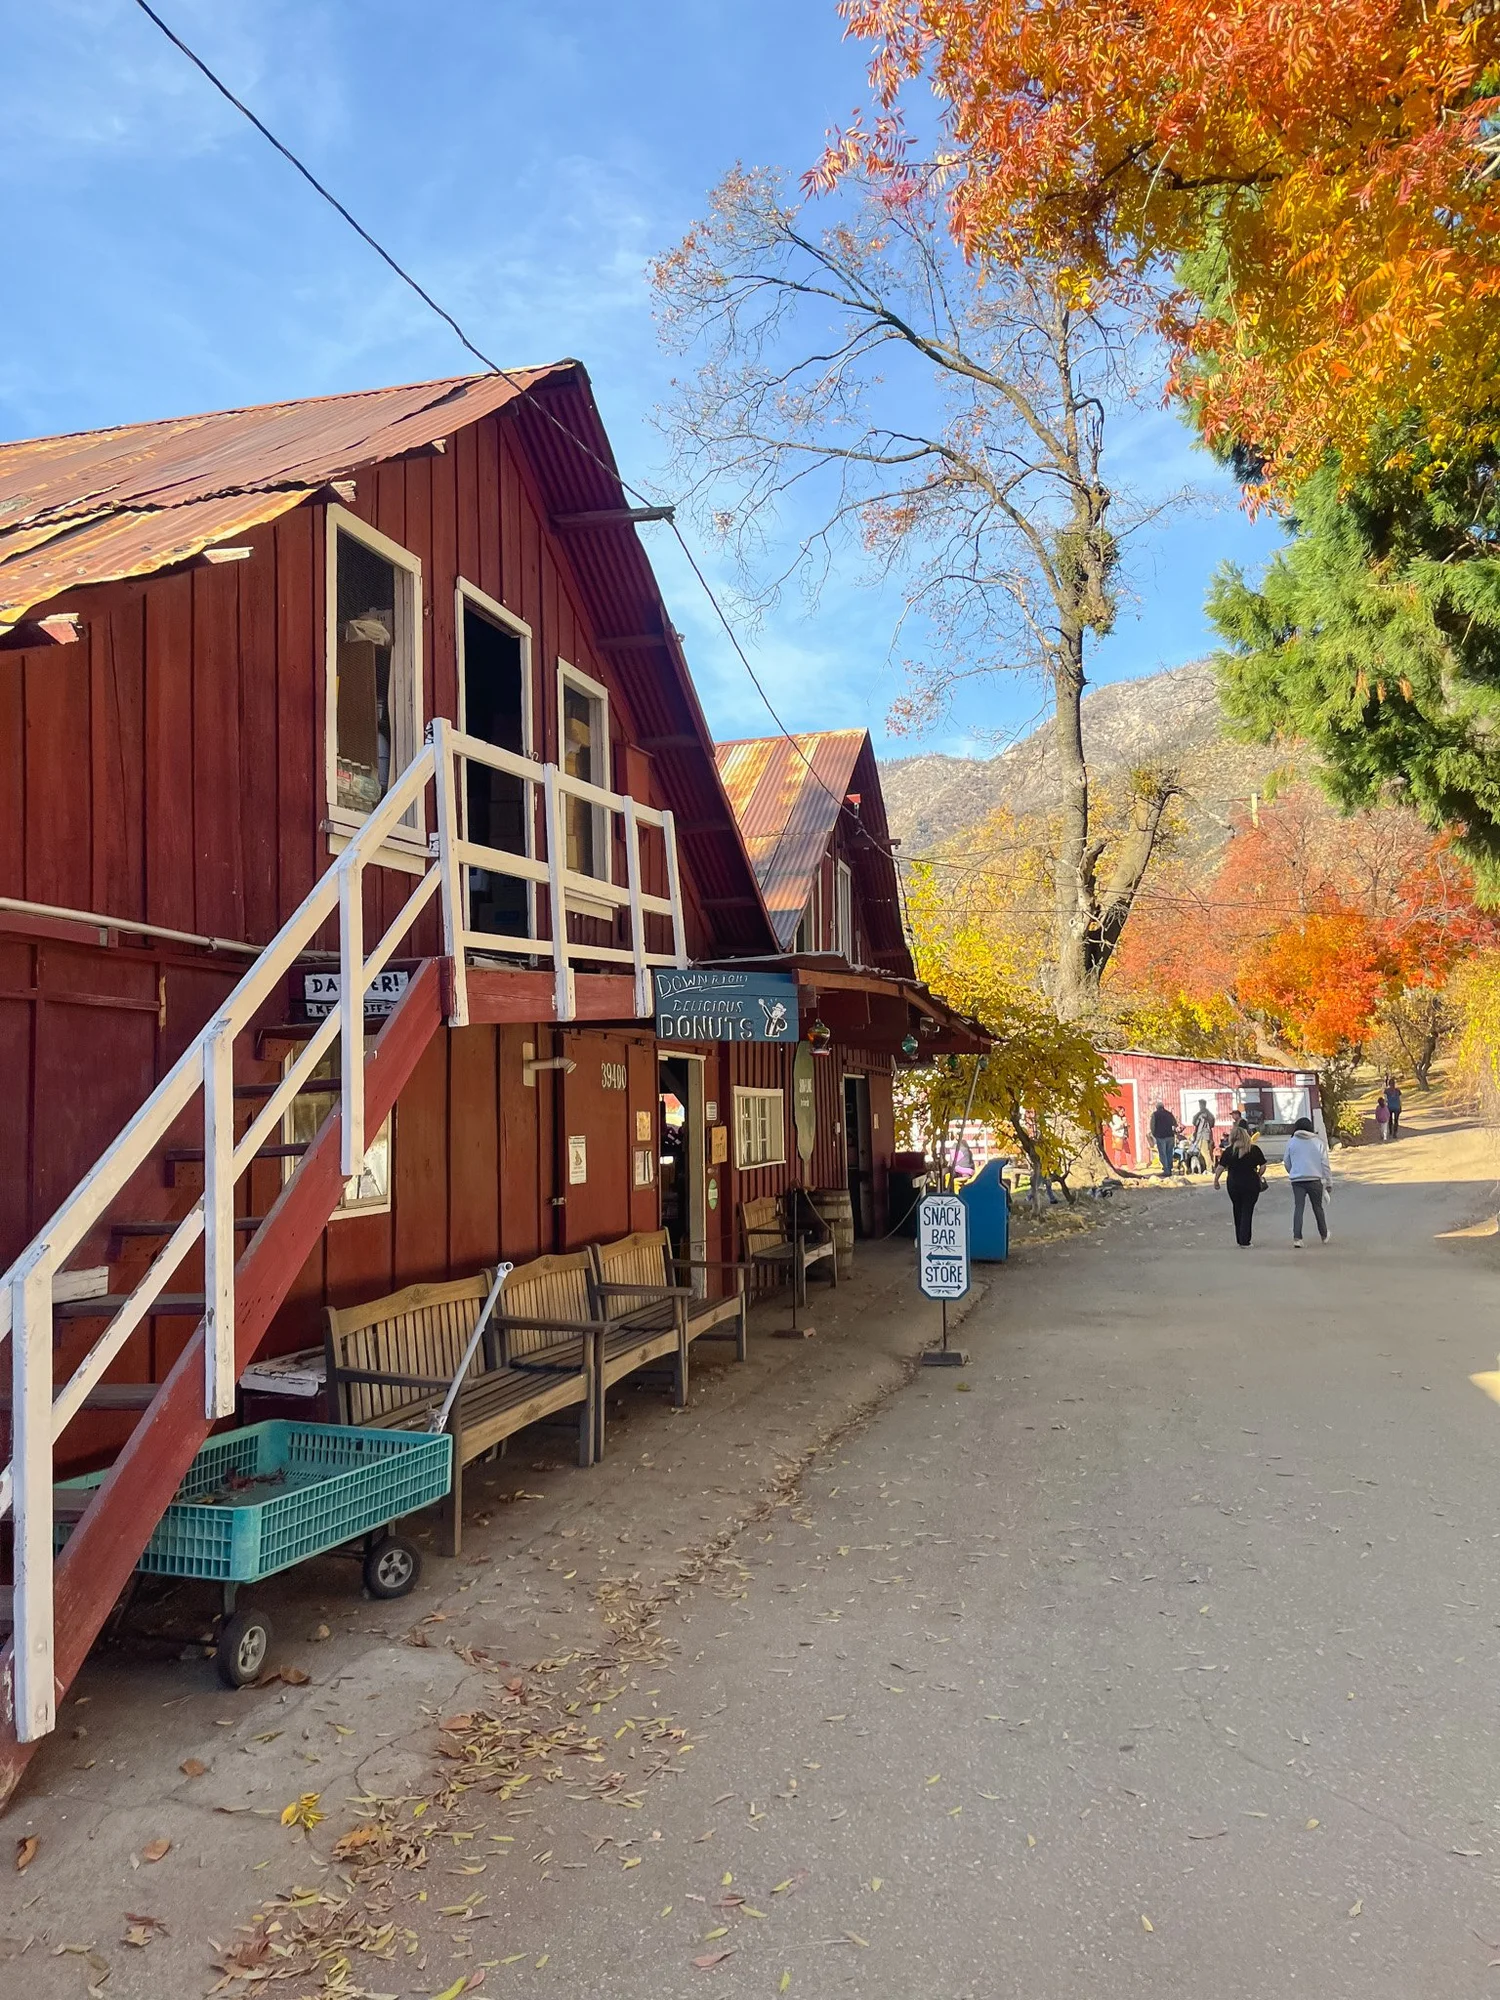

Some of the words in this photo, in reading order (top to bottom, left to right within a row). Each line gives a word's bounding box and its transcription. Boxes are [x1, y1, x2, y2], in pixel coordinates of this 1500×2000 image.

[312, 974, 399, 993] DAER!
[673, 1000, 744, 1013] DELICIOUS
[660, 1014, 753, 1041] DONUTS
[601, 1062, 627, 1089] 39400
[923, 1206, 961, 1226] SNACK
[931, 1229, 956, 1245] BAR
[925, 1265, 963, 1283] STORE
